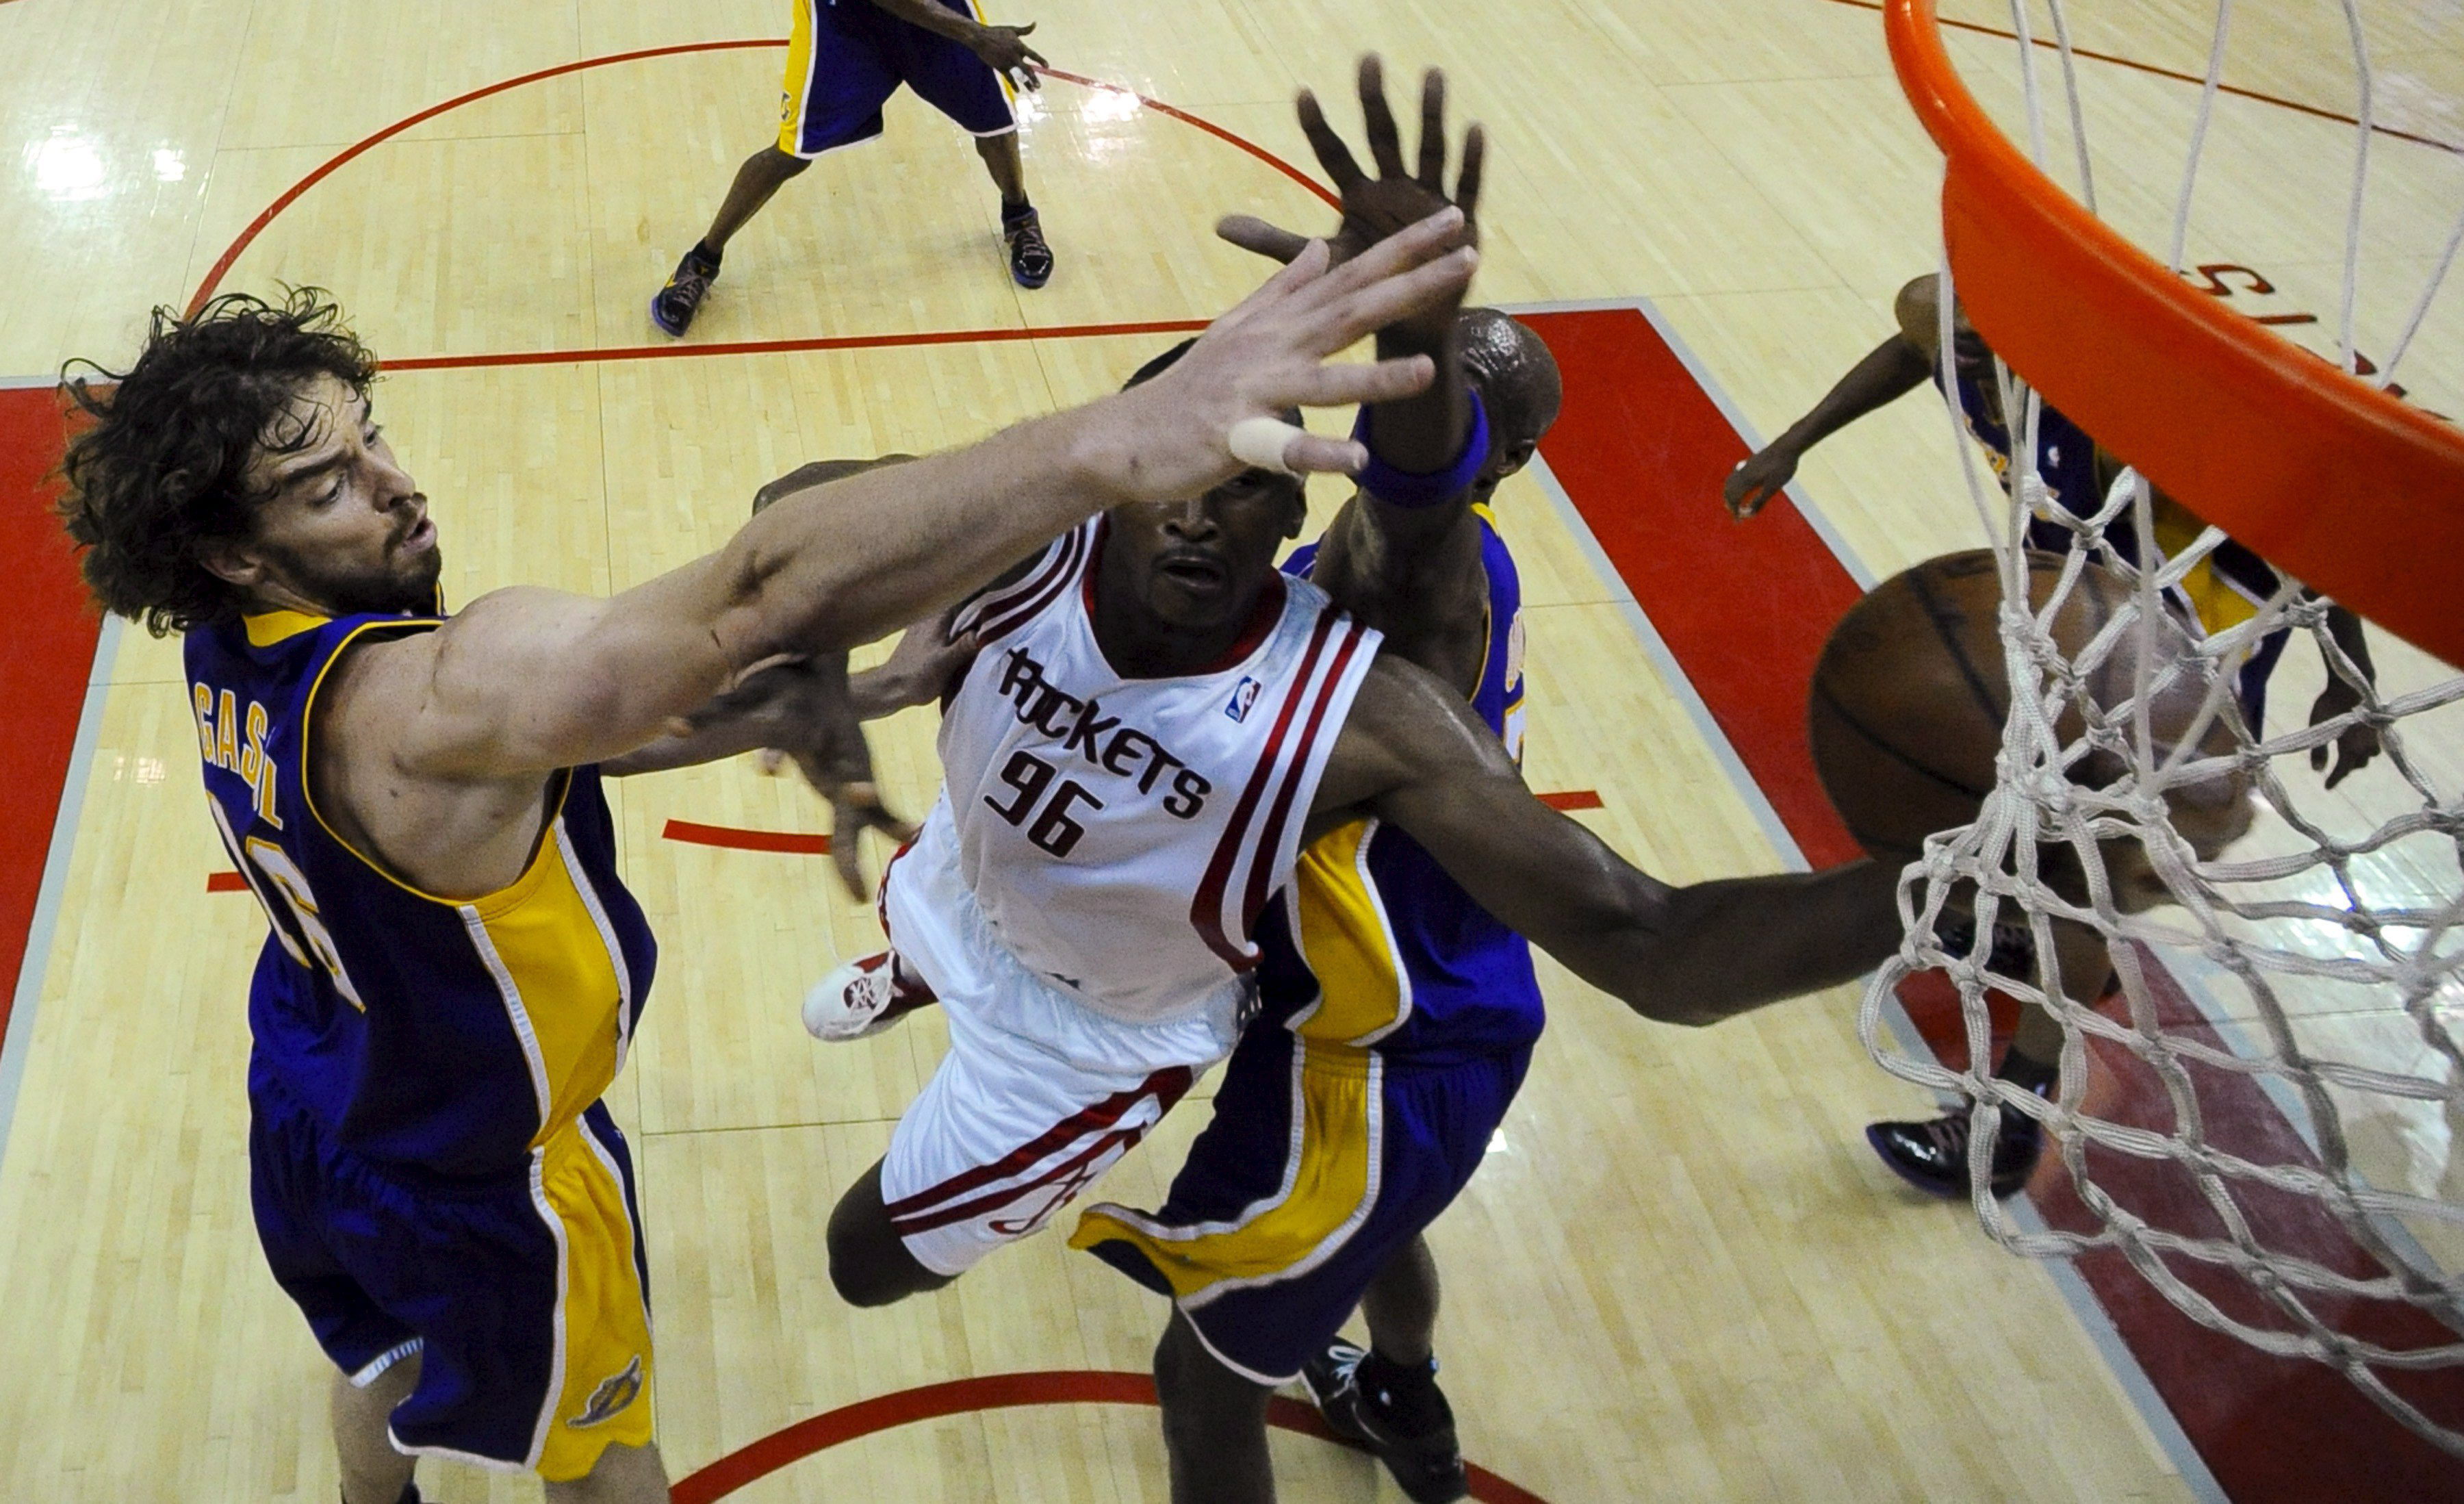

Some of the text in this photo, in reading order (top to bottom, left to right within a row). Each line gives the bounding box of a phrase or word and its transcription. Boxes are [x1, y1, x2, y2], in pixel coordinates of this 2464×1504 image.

[194, 682, 283, 830] GASL
[983, 750, 1104, 858] 96
[998, 646, 1212, 819] ROCKETS
